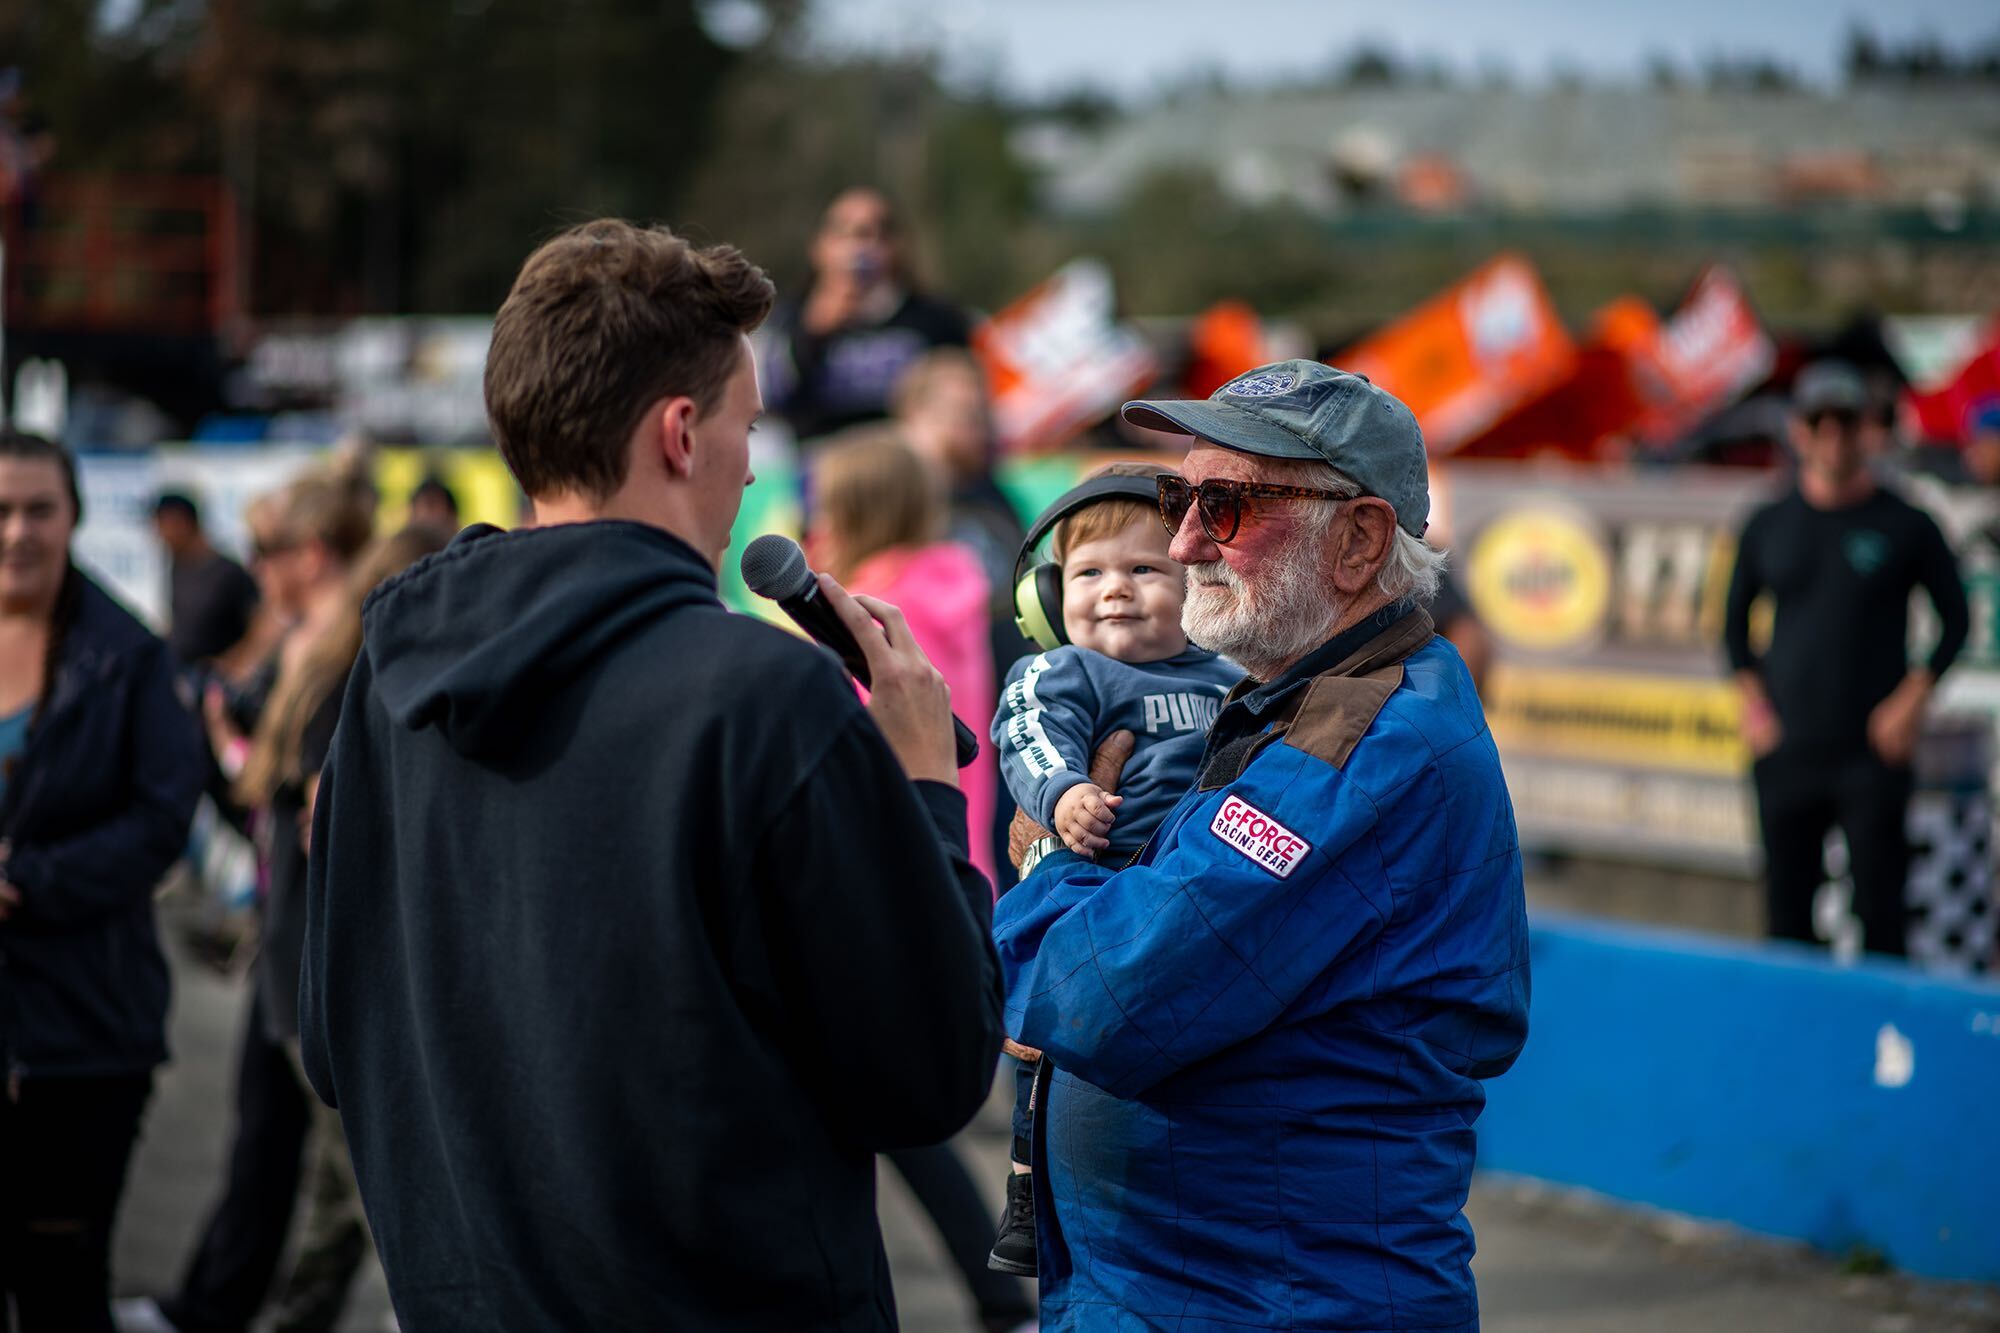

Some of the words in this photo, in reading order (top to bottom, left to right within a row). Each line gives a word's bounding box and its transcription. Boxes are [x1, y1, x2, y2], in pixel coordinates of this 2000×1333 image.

[1144, 692, 1219, 733] PUMA
[1215, 818, 1256, 851] RACING
[1256, 845, 1289, 872] GEAR
[1223, 802, 1304, 862] G-FORCE
